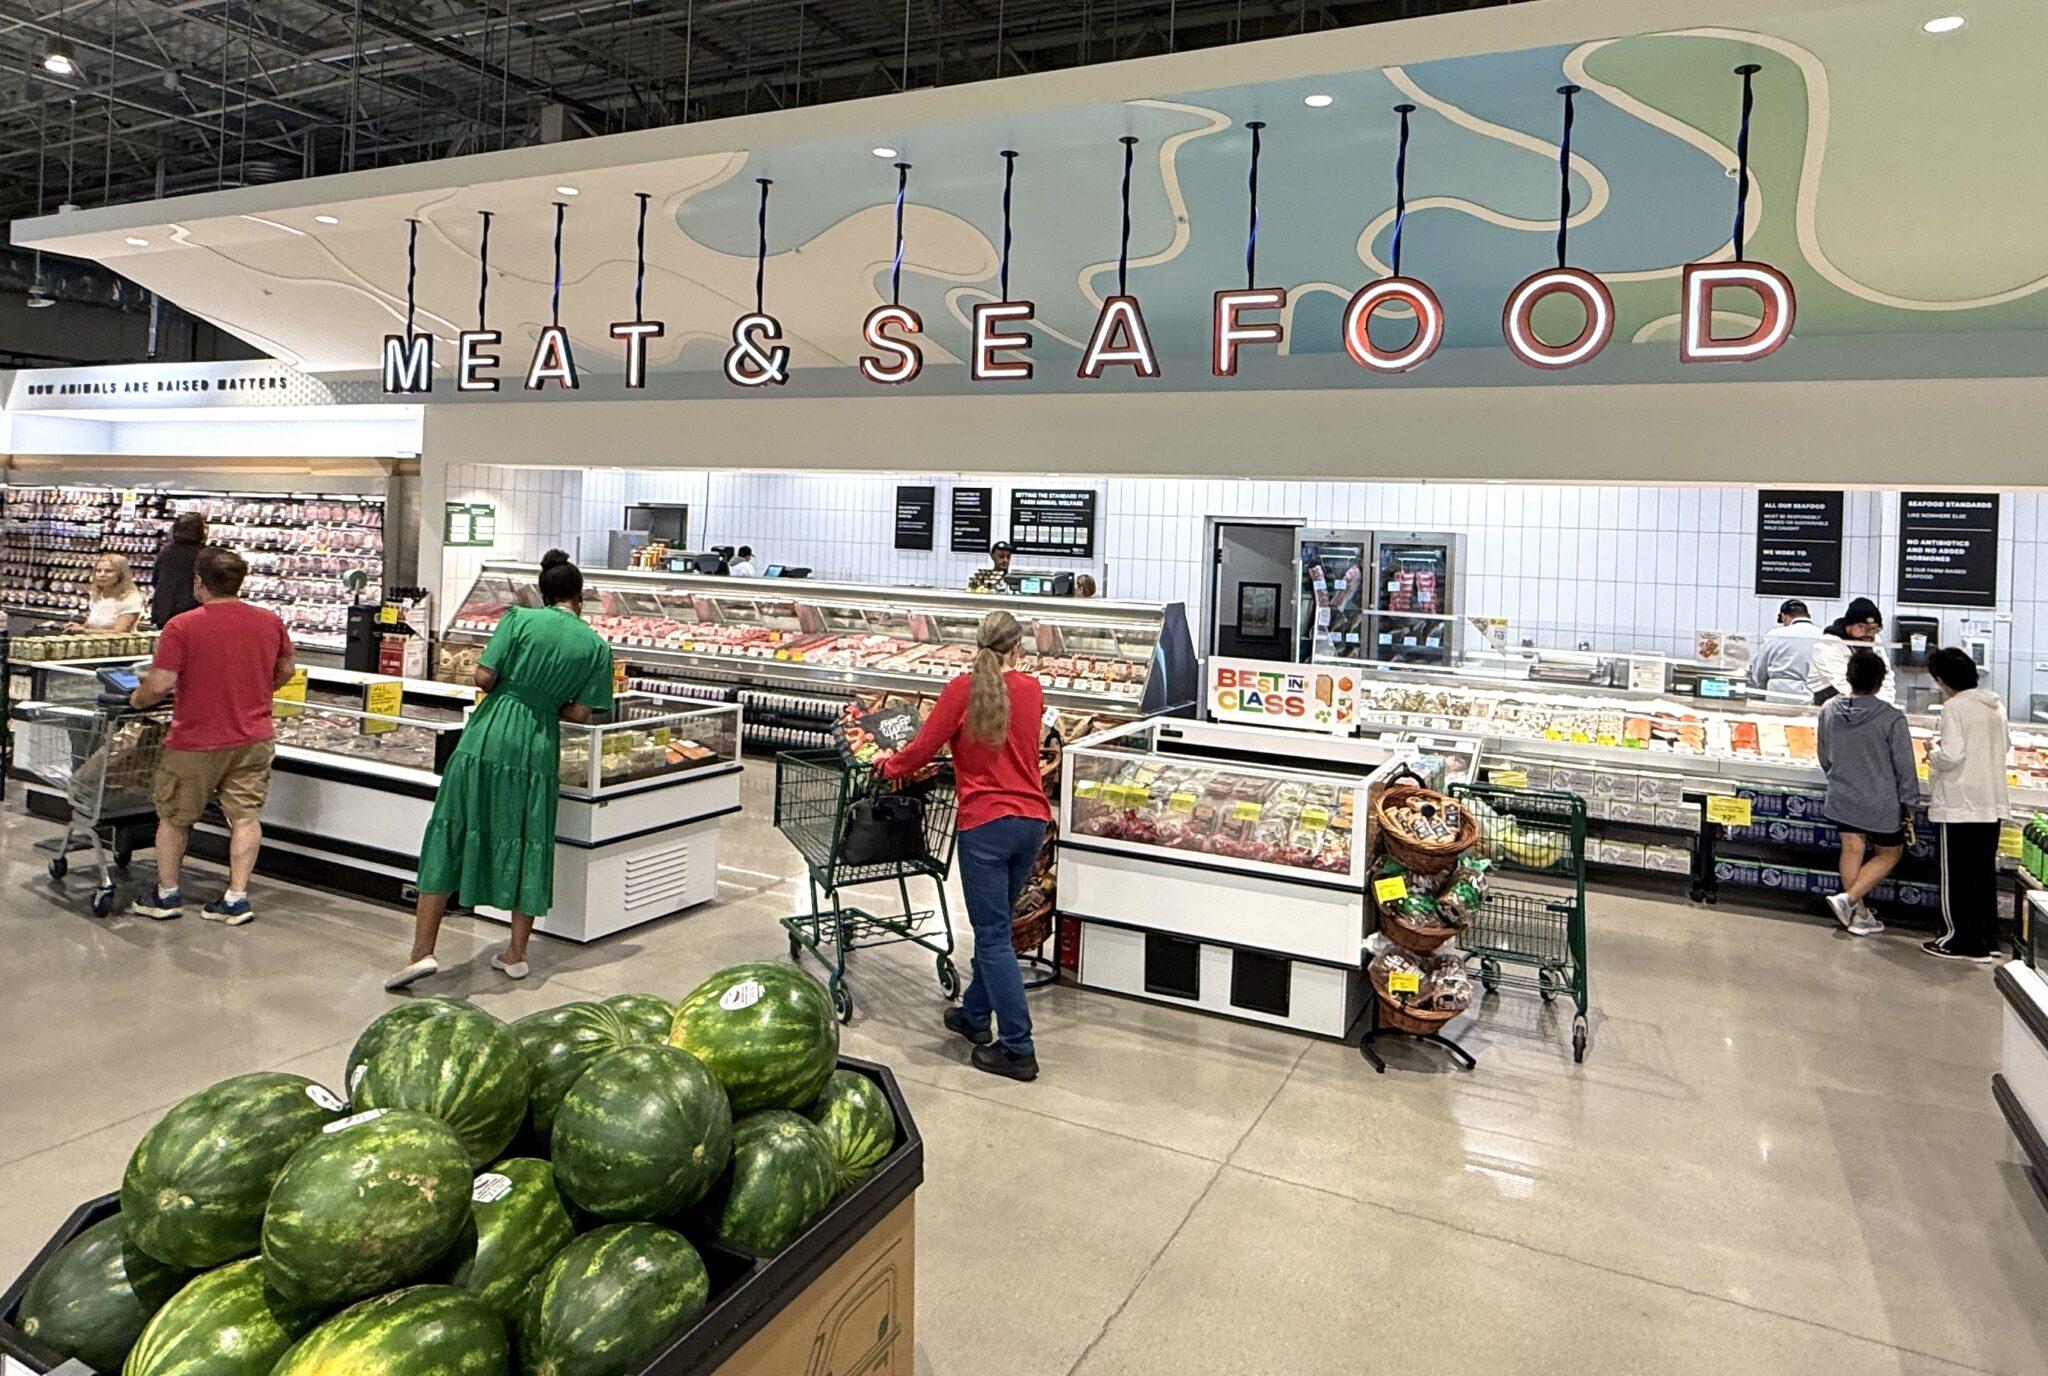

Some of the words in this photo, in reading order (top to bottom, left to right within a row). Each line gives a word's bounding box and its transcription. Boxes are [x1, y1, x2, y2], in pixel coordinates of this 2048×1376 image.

[384, 321, 664, 394] MEAT
[725, 314, 790, 387] &
[859, 261, 1796, 387] SEAFOOD
[28, 385, 54, 395] HOW
[60, 383, 117, 394] ANIMALS
[124, 382, 149, 394] ARE
[157, 379, 210, 392] RAISED
[217, 377, 287, 391] MATTERS
[1217, 668, 1285, 693] BEST
[1288, 678, 1304, 689] IN
[1217, 689, 1306, 717] CLASS
